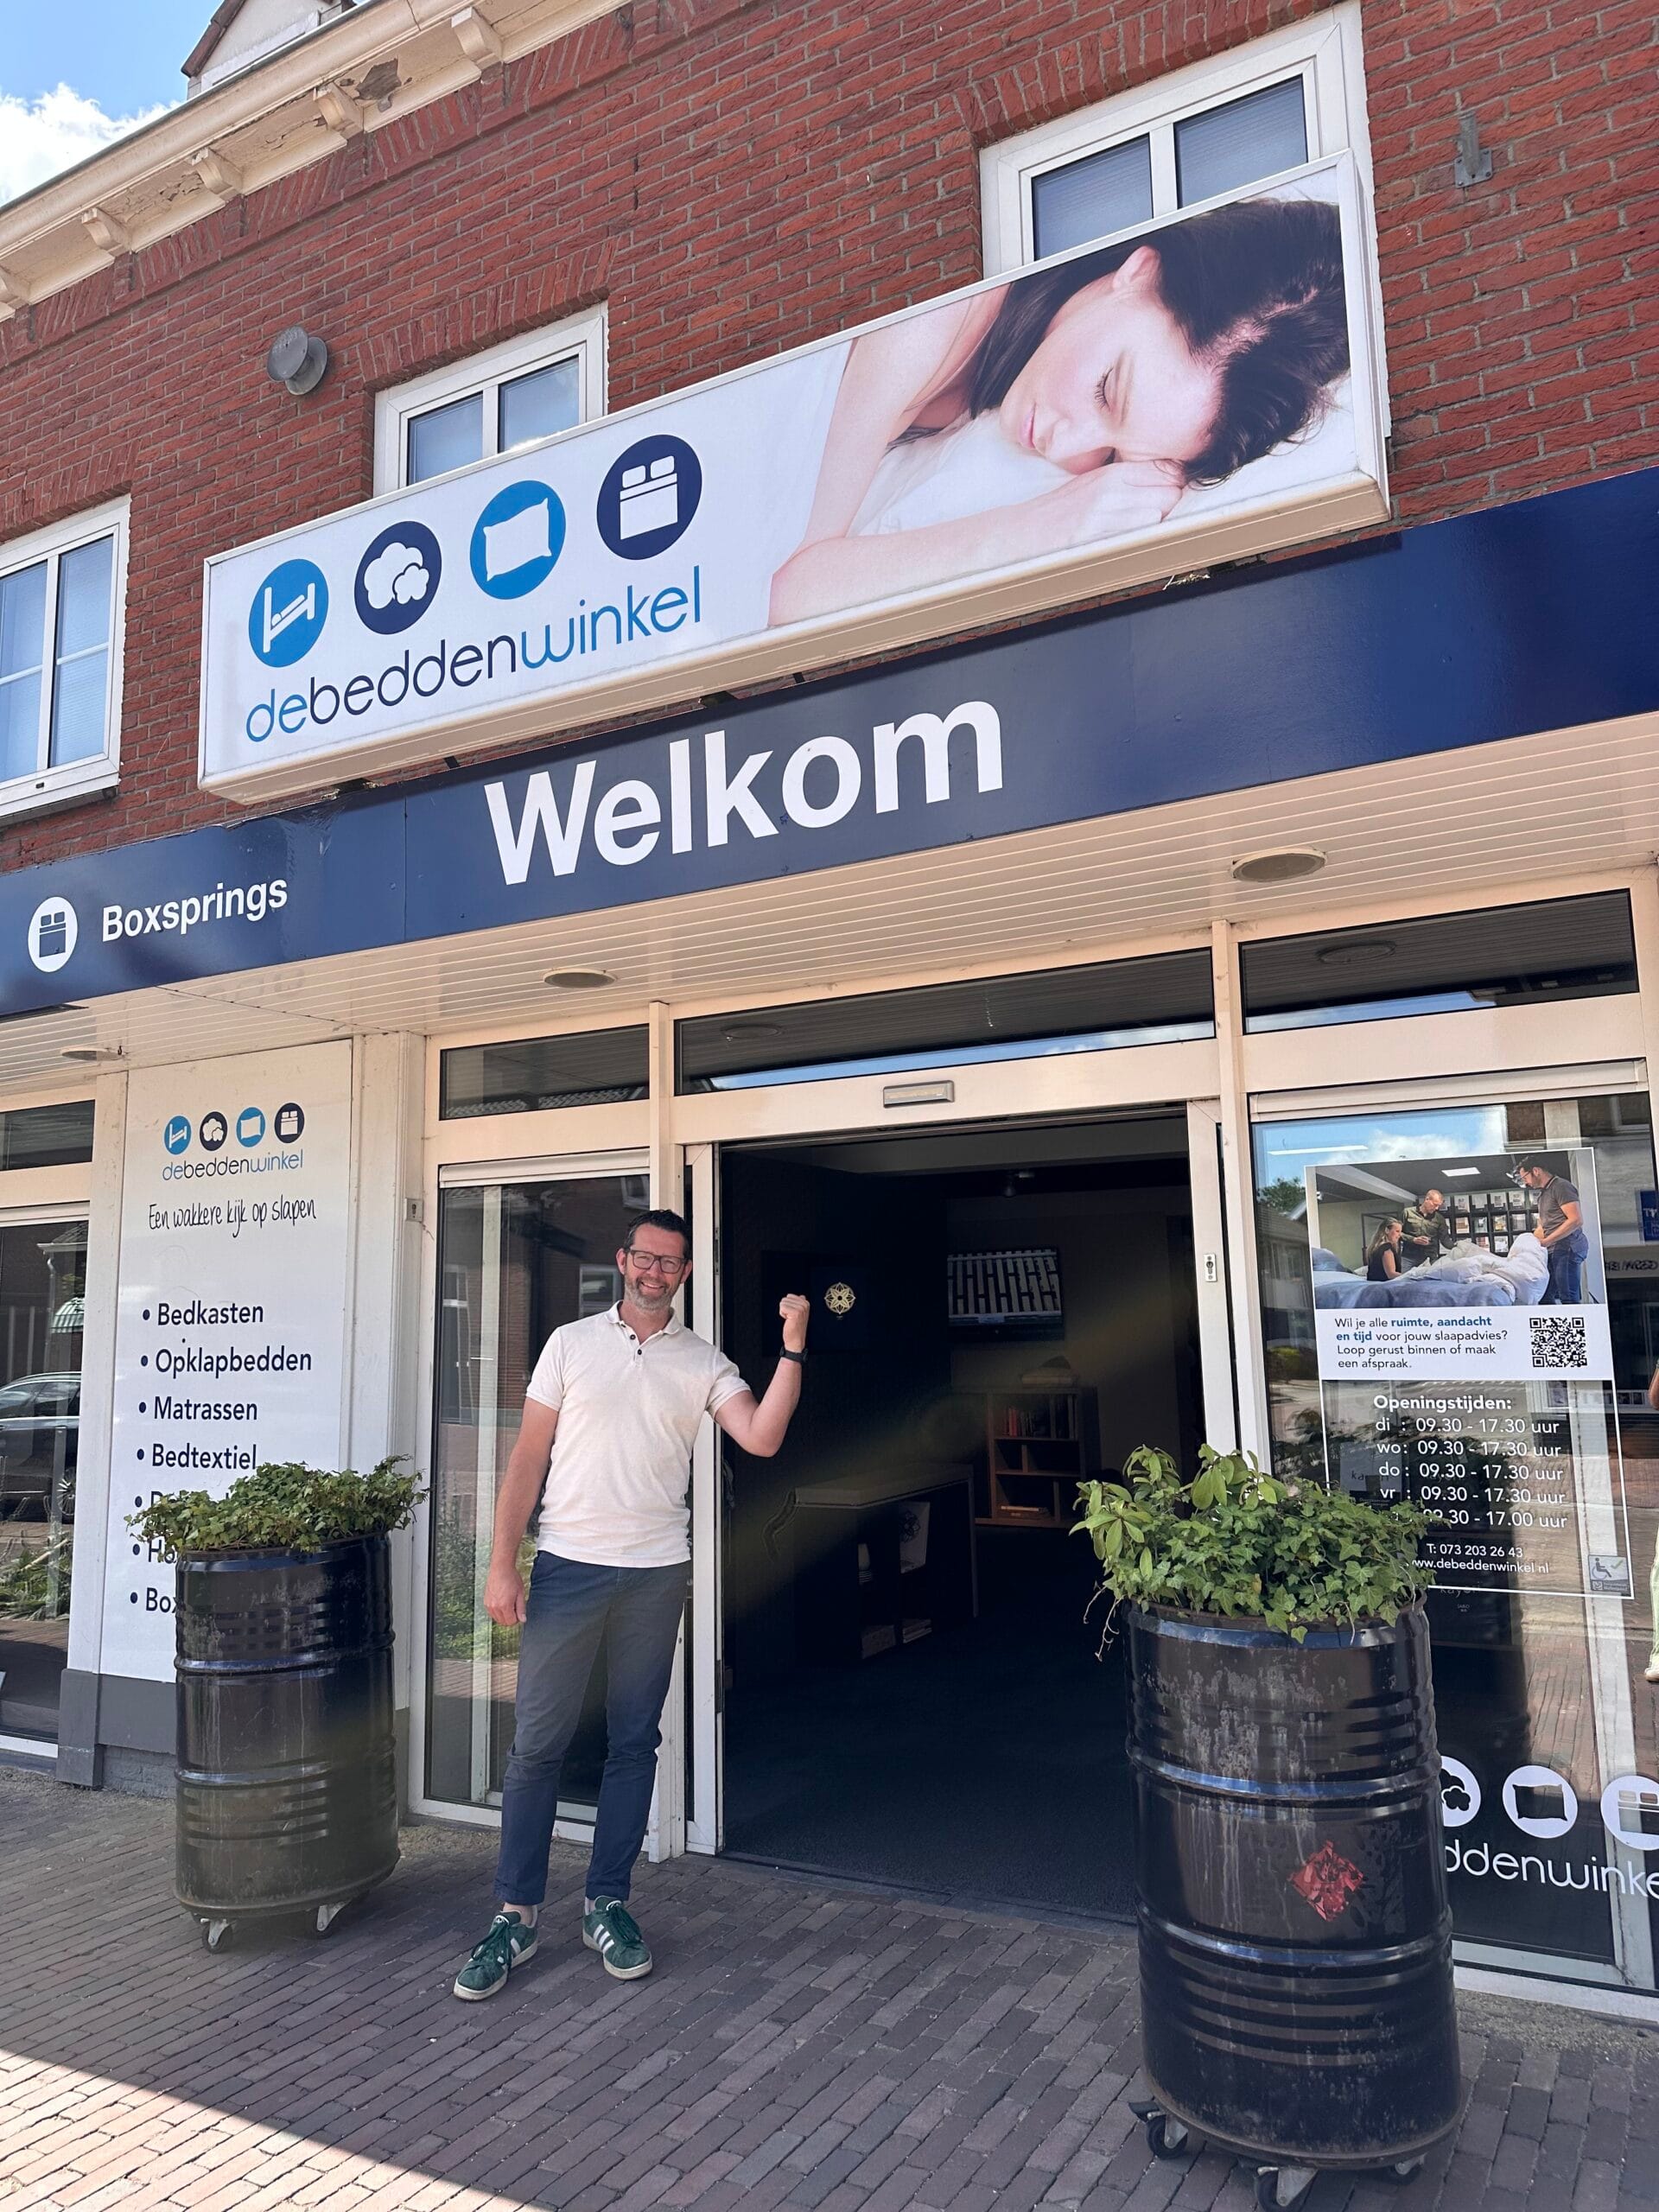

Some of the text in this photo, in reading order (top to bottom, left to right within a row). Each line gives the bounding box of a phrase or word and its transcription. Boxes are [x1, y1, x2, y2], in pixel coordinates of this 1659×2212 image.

[246, 566, 700, 742] debeddenwinkel
[484, 701, 1003, 886] Welkom
[102, 879, 288, 942] Boxsprings
[162, 1150, 303, 1180] debeddenwinkel
[149, 1194, 317, 1238] Een wakkere kijk op slapen
[157, 1300, 264, 1325] Bedkasten
[1335, 1316, 1492, 1330] Wil je alle ruimte, aandacht
[1353, 1332, 1372, 1343] tijd
[1403, 1332, 1432, 1343] jouw
[1434, 1330, 1508, 1343] slaapadvies?
[1338, 1344, 1497, 1357] Loop gerust binnen of maak
[156, 1345, 312, 1379] Opklapbedden
[1338, 1358, 1413, 1370] een afspraak.
[154, 1396, 258, 1421] Matrassen
[1373, 1395, 1512, 1414] Openingstijden:
[1416, 1418, 1462, 1432] 09.30
[1479, 1419, 1526, 1433] 17.30
[1531, 1423, 1560, 1433] uur
[152, 1443, 257, 1469] Bedtextiel
[1418, 1440, 1464, 1454] 09.30
[1481, 1441, 1528, 1456] 17.30
[1533, 1446, 1562, 1458] uur
[1420, 1463, 1465, 1478] 09.30
[1483, 1464, 1529, 1479] 17.30
[1535, 1470, 1564, 1480] uur
[1380, 1488, 1396, 1498] vr
[1421, 1486, 1467, 1501] 09.30
[1484, 1488, 1531, 1503] 17.30
[1537, 1493, 1566, 1503] uur
[1486, 1510, 1533, 1527] 17.00
[1539, 1516, 1567, 1528] uur
[1427, 1543, 1522, 1558] T: 073 203 26 43
